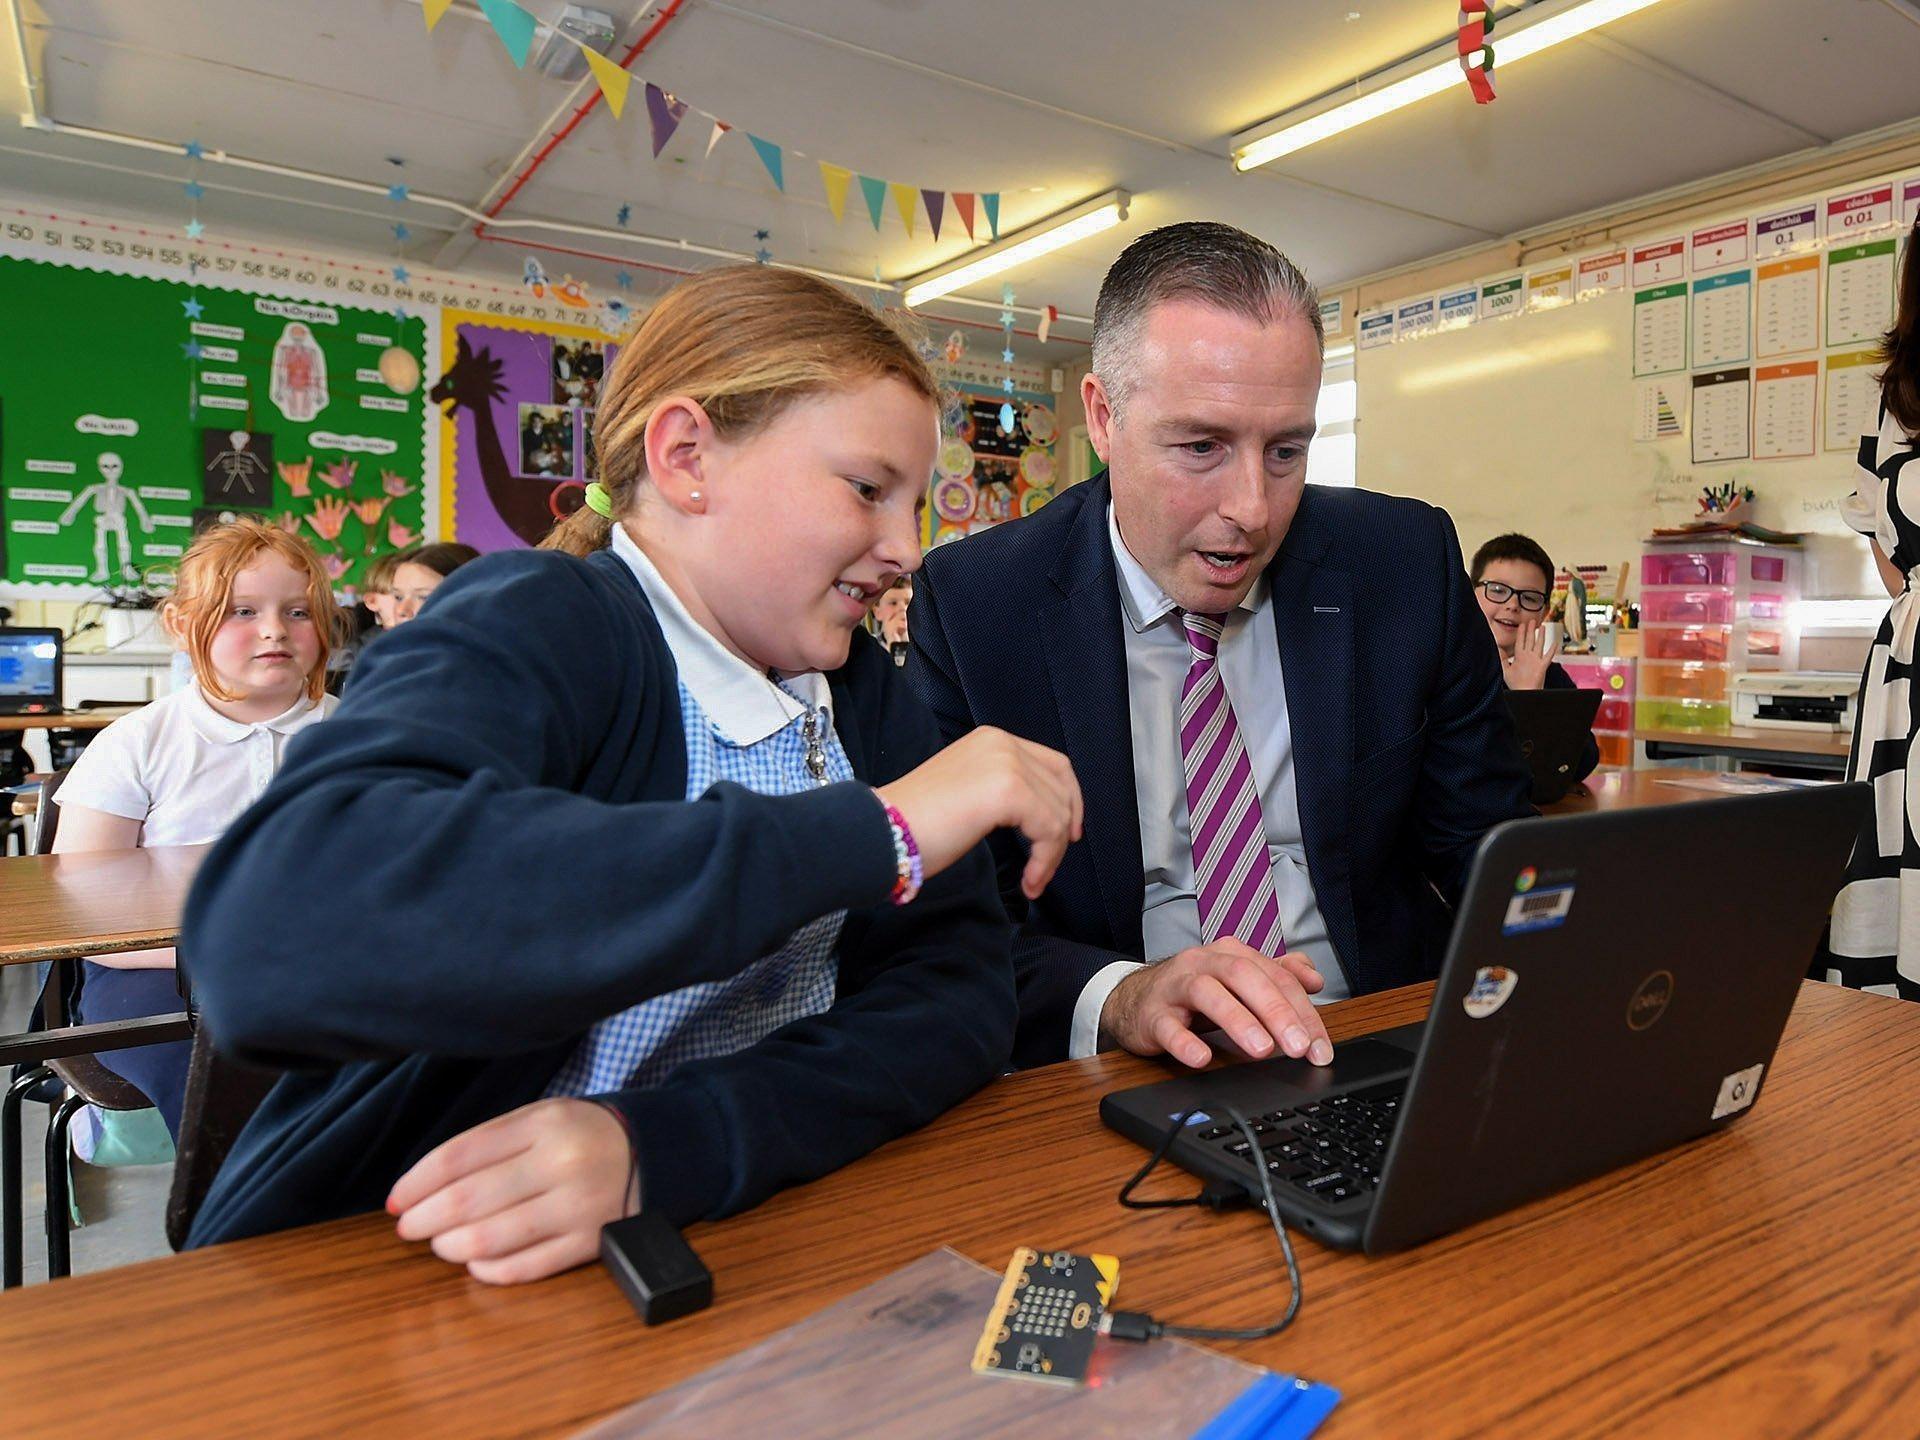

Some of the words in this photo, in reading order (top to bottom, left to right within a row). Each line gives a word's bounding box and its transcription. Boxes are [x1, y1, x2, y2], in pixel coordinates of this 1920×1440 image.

[1844, 211, 1873, 227] 0.01
[1776, 231, 1794, 245] 0.1
[8, 223, 33, 241] 50
[44, 230, 62, 247] 51
[72, 234, 94, 251] 52
[102, 239, 124, 256] 53
[130, 244, 153, 260] 54
[159, 248, 182, 265] 55
[188, 252, 210, 269] 56
[216, 257, 236, 272] 57
[242, 260, 264, 277] 58
[269, 264, 290, 280] 59
[295, 270, 316, 284] 60
[324, 274, 339, 289] 61
[347, 278, 366, 293] 62
[371, 282, 390, 297] 63
[394, 286, 413, 299] 64
[418, 290, 437, 304] 65
[465, 298, 480, 310] 67
[530, 307, 546, 319] 70
[555, 307, 567, 320] 71
[574, 310, 587, 324] 72
[1654, 263, 1661, 273] 1
[1596, 271, 1608, 282] 10
[1491, 295, 1513, 308] 1000
[1445, 309, 1456, 320] 10
[1458, 306, 1473, 317] 000
[1401, 318, 1415, 330] 100
[1416, 314, 1432, 325] 000
